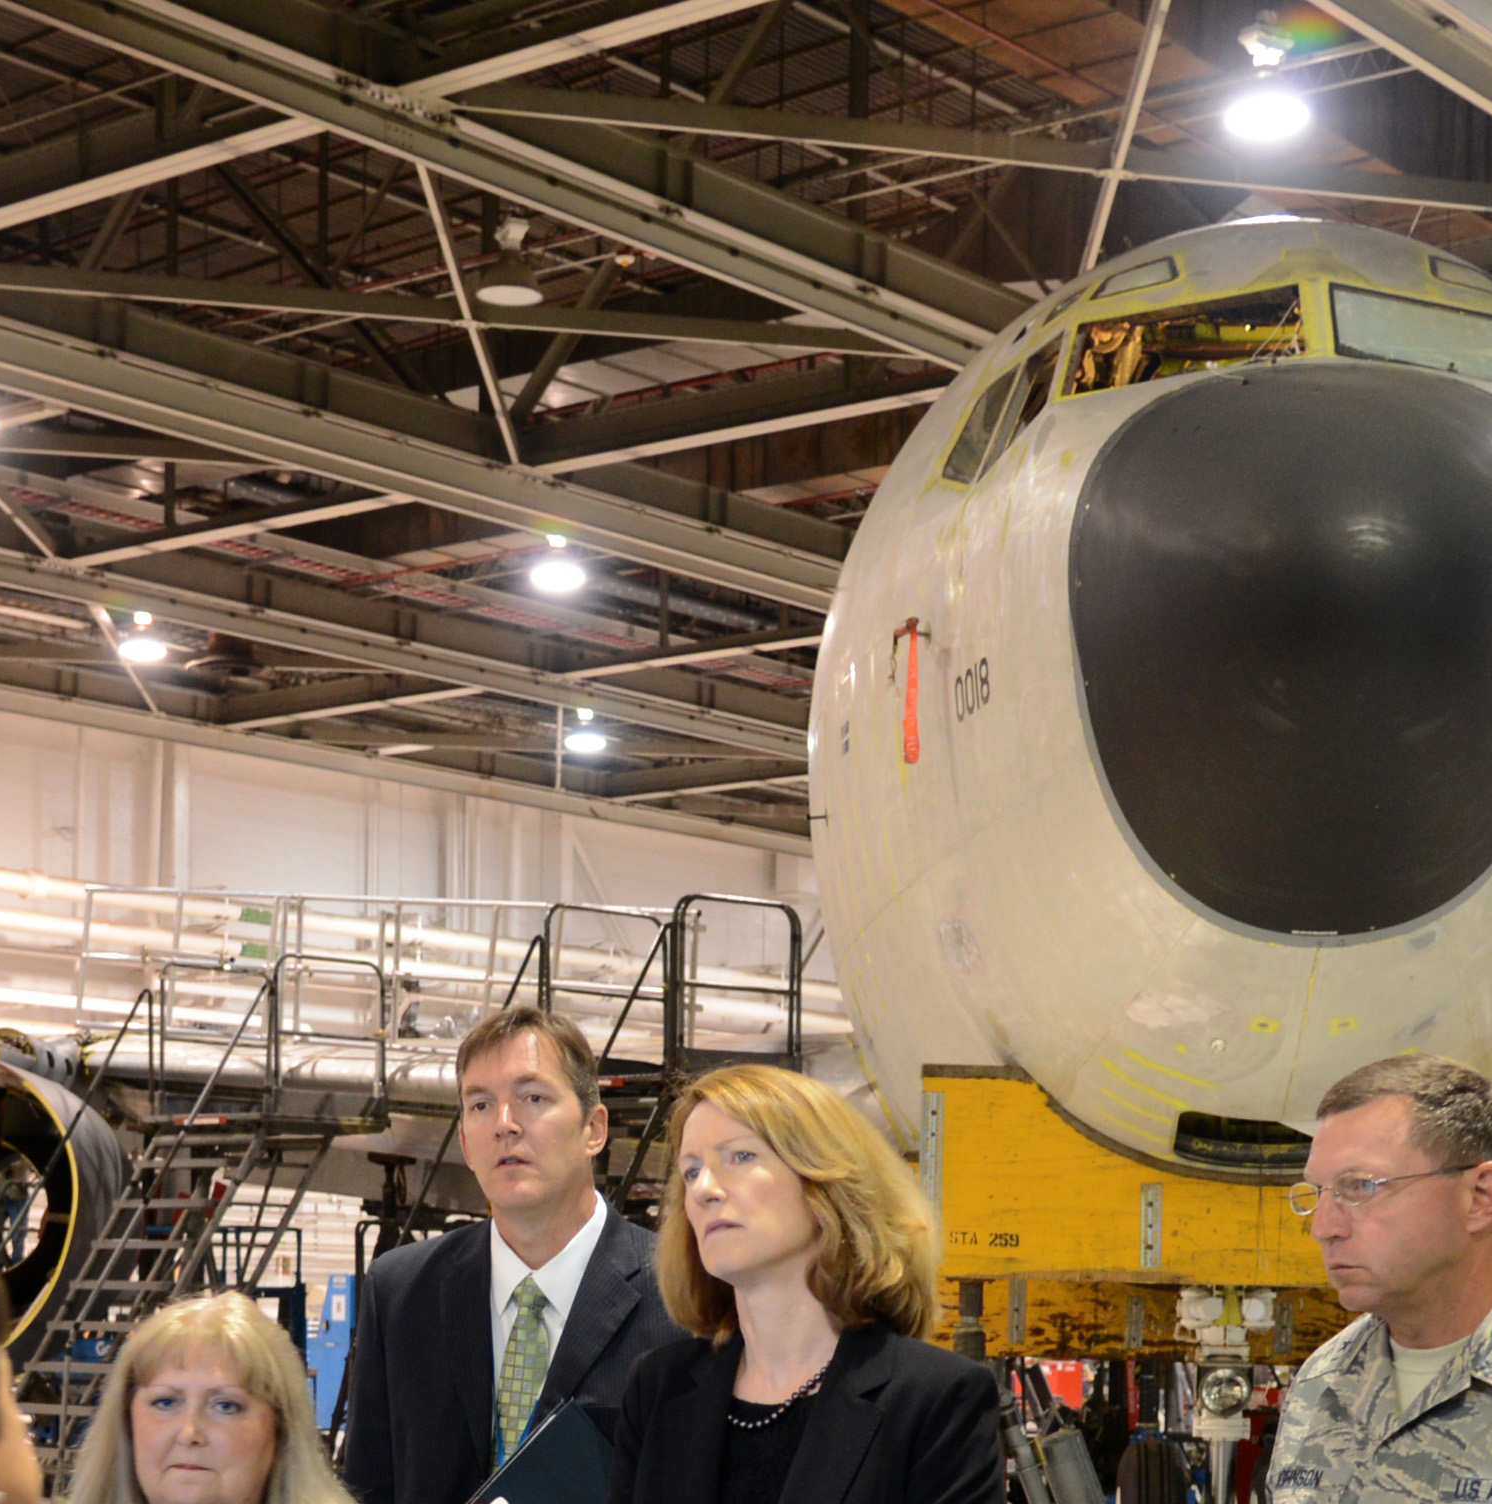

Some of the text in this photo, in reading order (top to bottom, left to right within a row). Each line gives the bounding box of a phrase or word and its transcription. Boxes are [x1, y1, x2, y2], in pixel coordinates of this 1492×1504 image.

[955, 656, 990, 721] 0018
[949, 1231, 1019, 1247] STA 259
